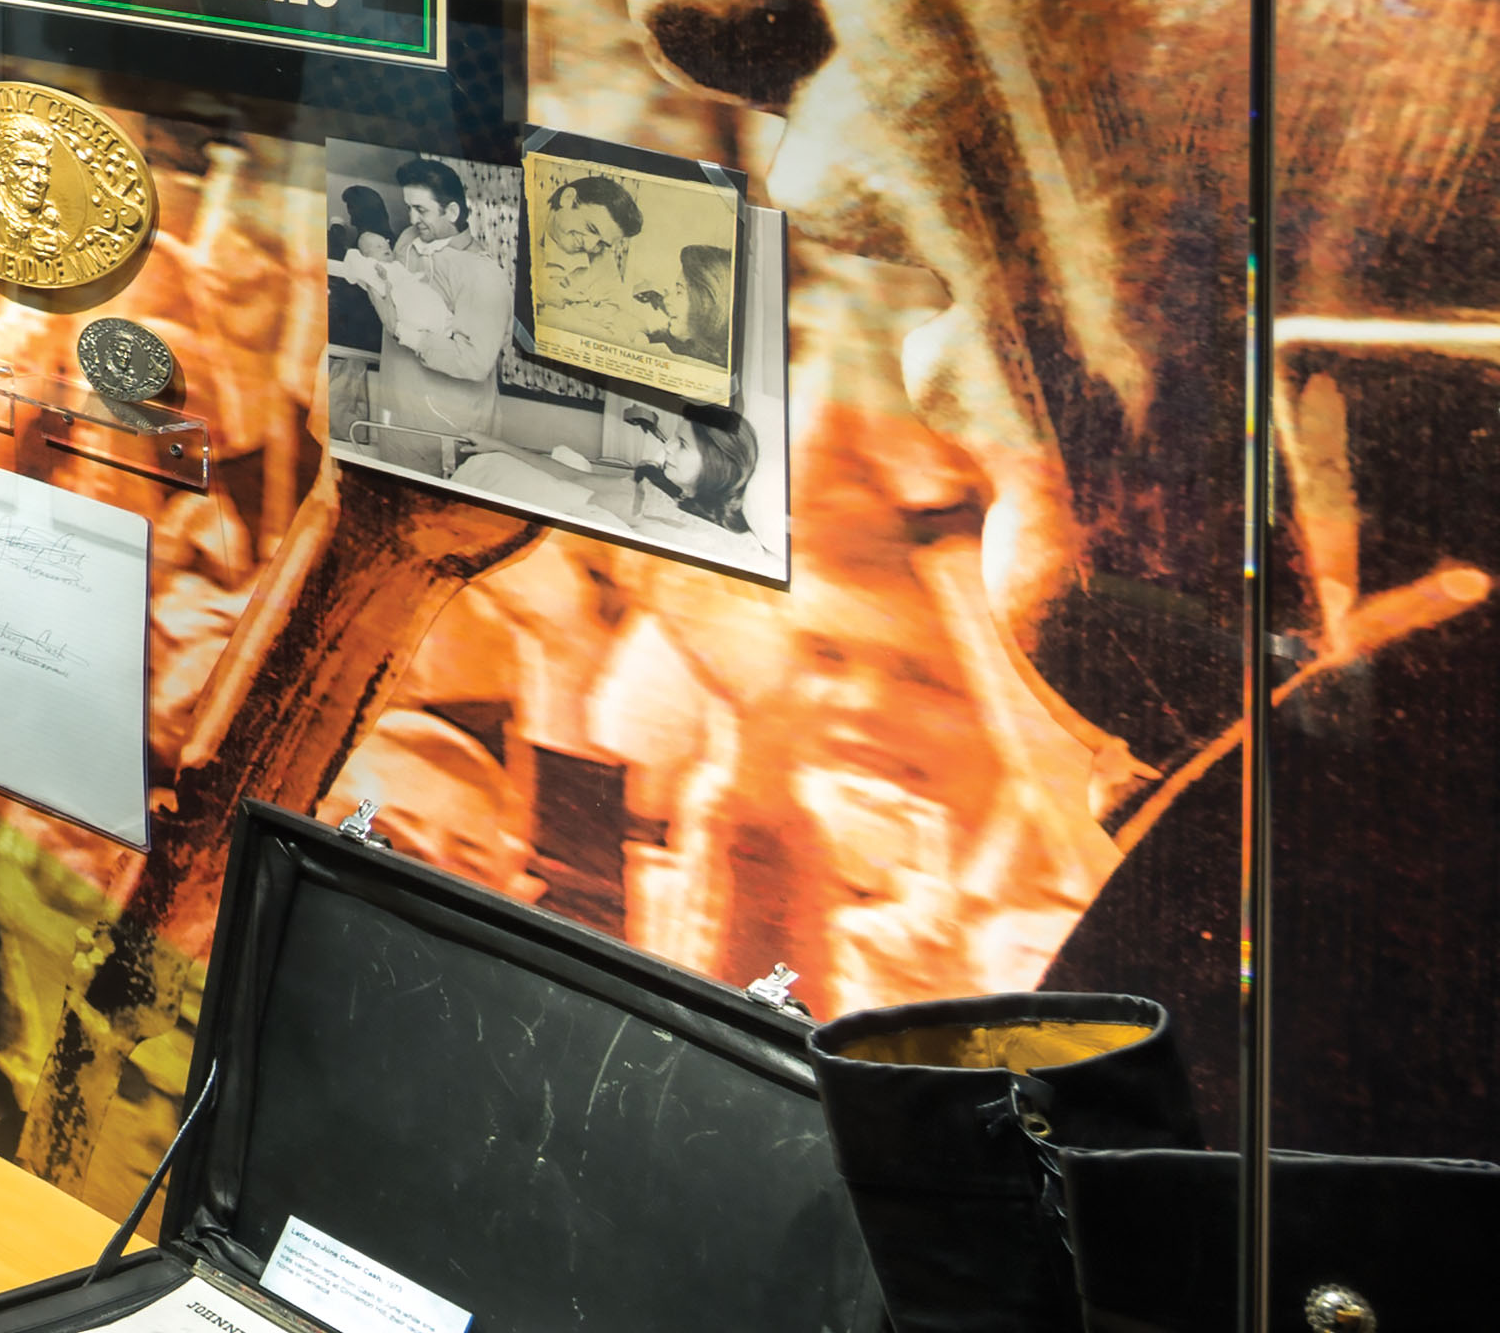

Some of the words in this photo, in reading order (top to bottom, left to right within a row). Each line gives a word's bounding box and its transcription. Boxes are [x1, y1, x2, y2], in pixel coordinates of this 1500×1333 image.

[48, 98, 120, 155] CASH
[579, 338, 592, 350] HE
[619, 349, 645, 364] NAME
[645, 356, 653, 366] IT
[655, 359, 670, 370] SUE
[290, 1227, 312, 1243] Letter
[312, 1239, 321, 1248] to
[320, 1243, 339, 1259] June
[339, 1254, 362, 1270] Carter
[186, 1301, 246, 1333] JOHNN
